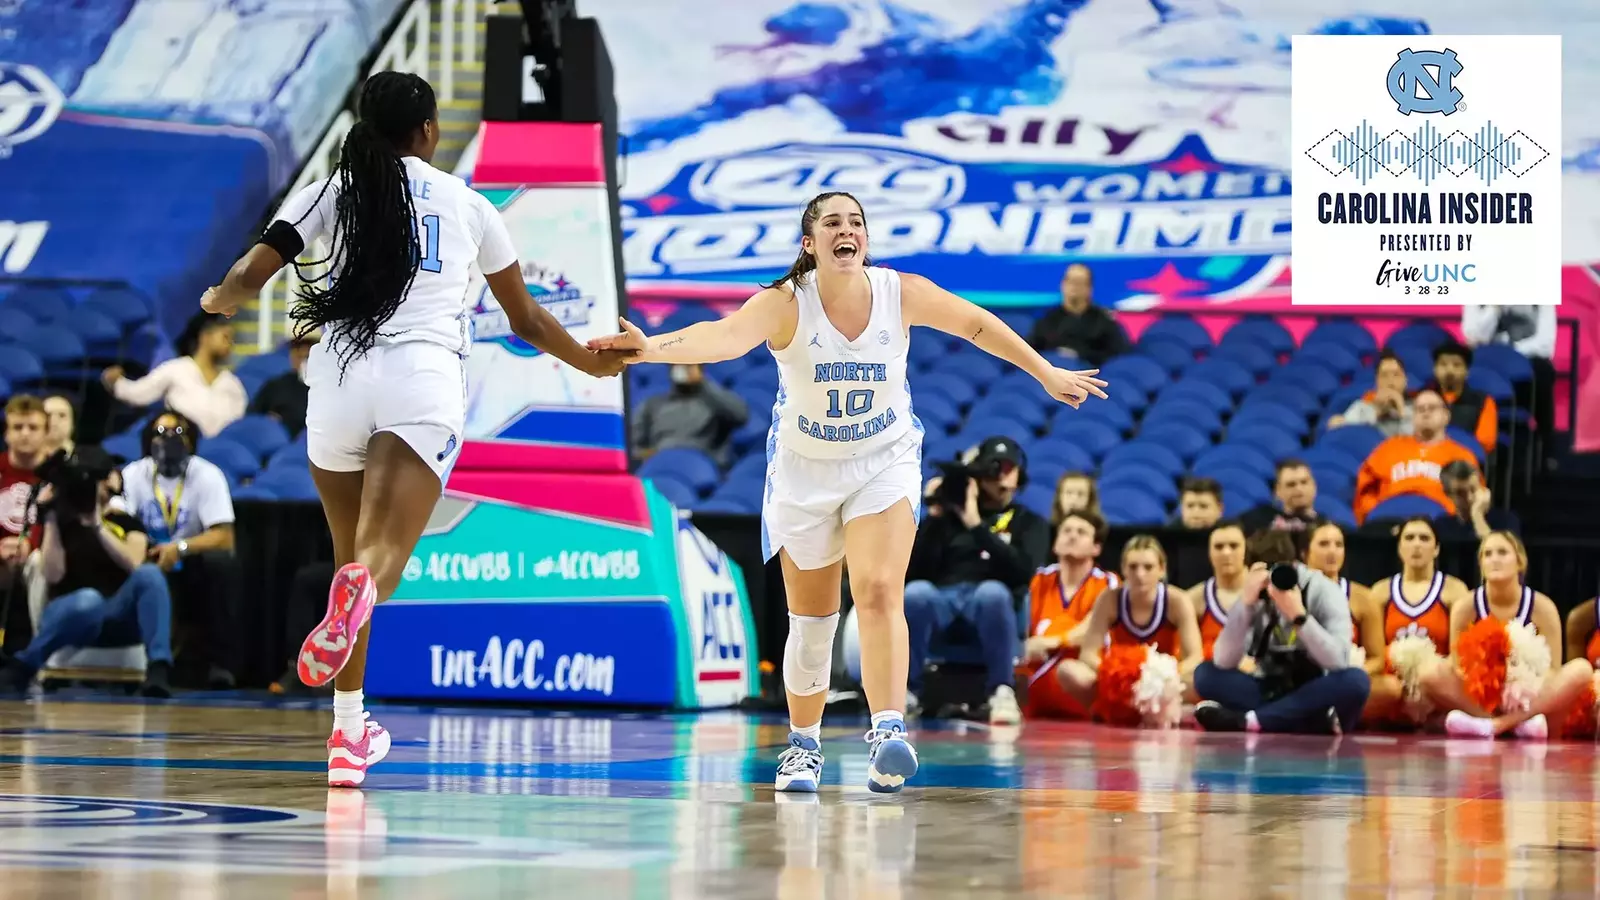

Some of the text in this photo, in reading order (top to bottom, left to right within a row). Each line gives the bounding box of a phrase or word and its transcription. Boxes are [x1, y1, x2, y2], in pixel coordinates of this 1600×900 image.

[814, 362, 887, 384] NORTH
[826, 388, 875, 418] 10
[797, 407, 898, 442] CAROLINA
